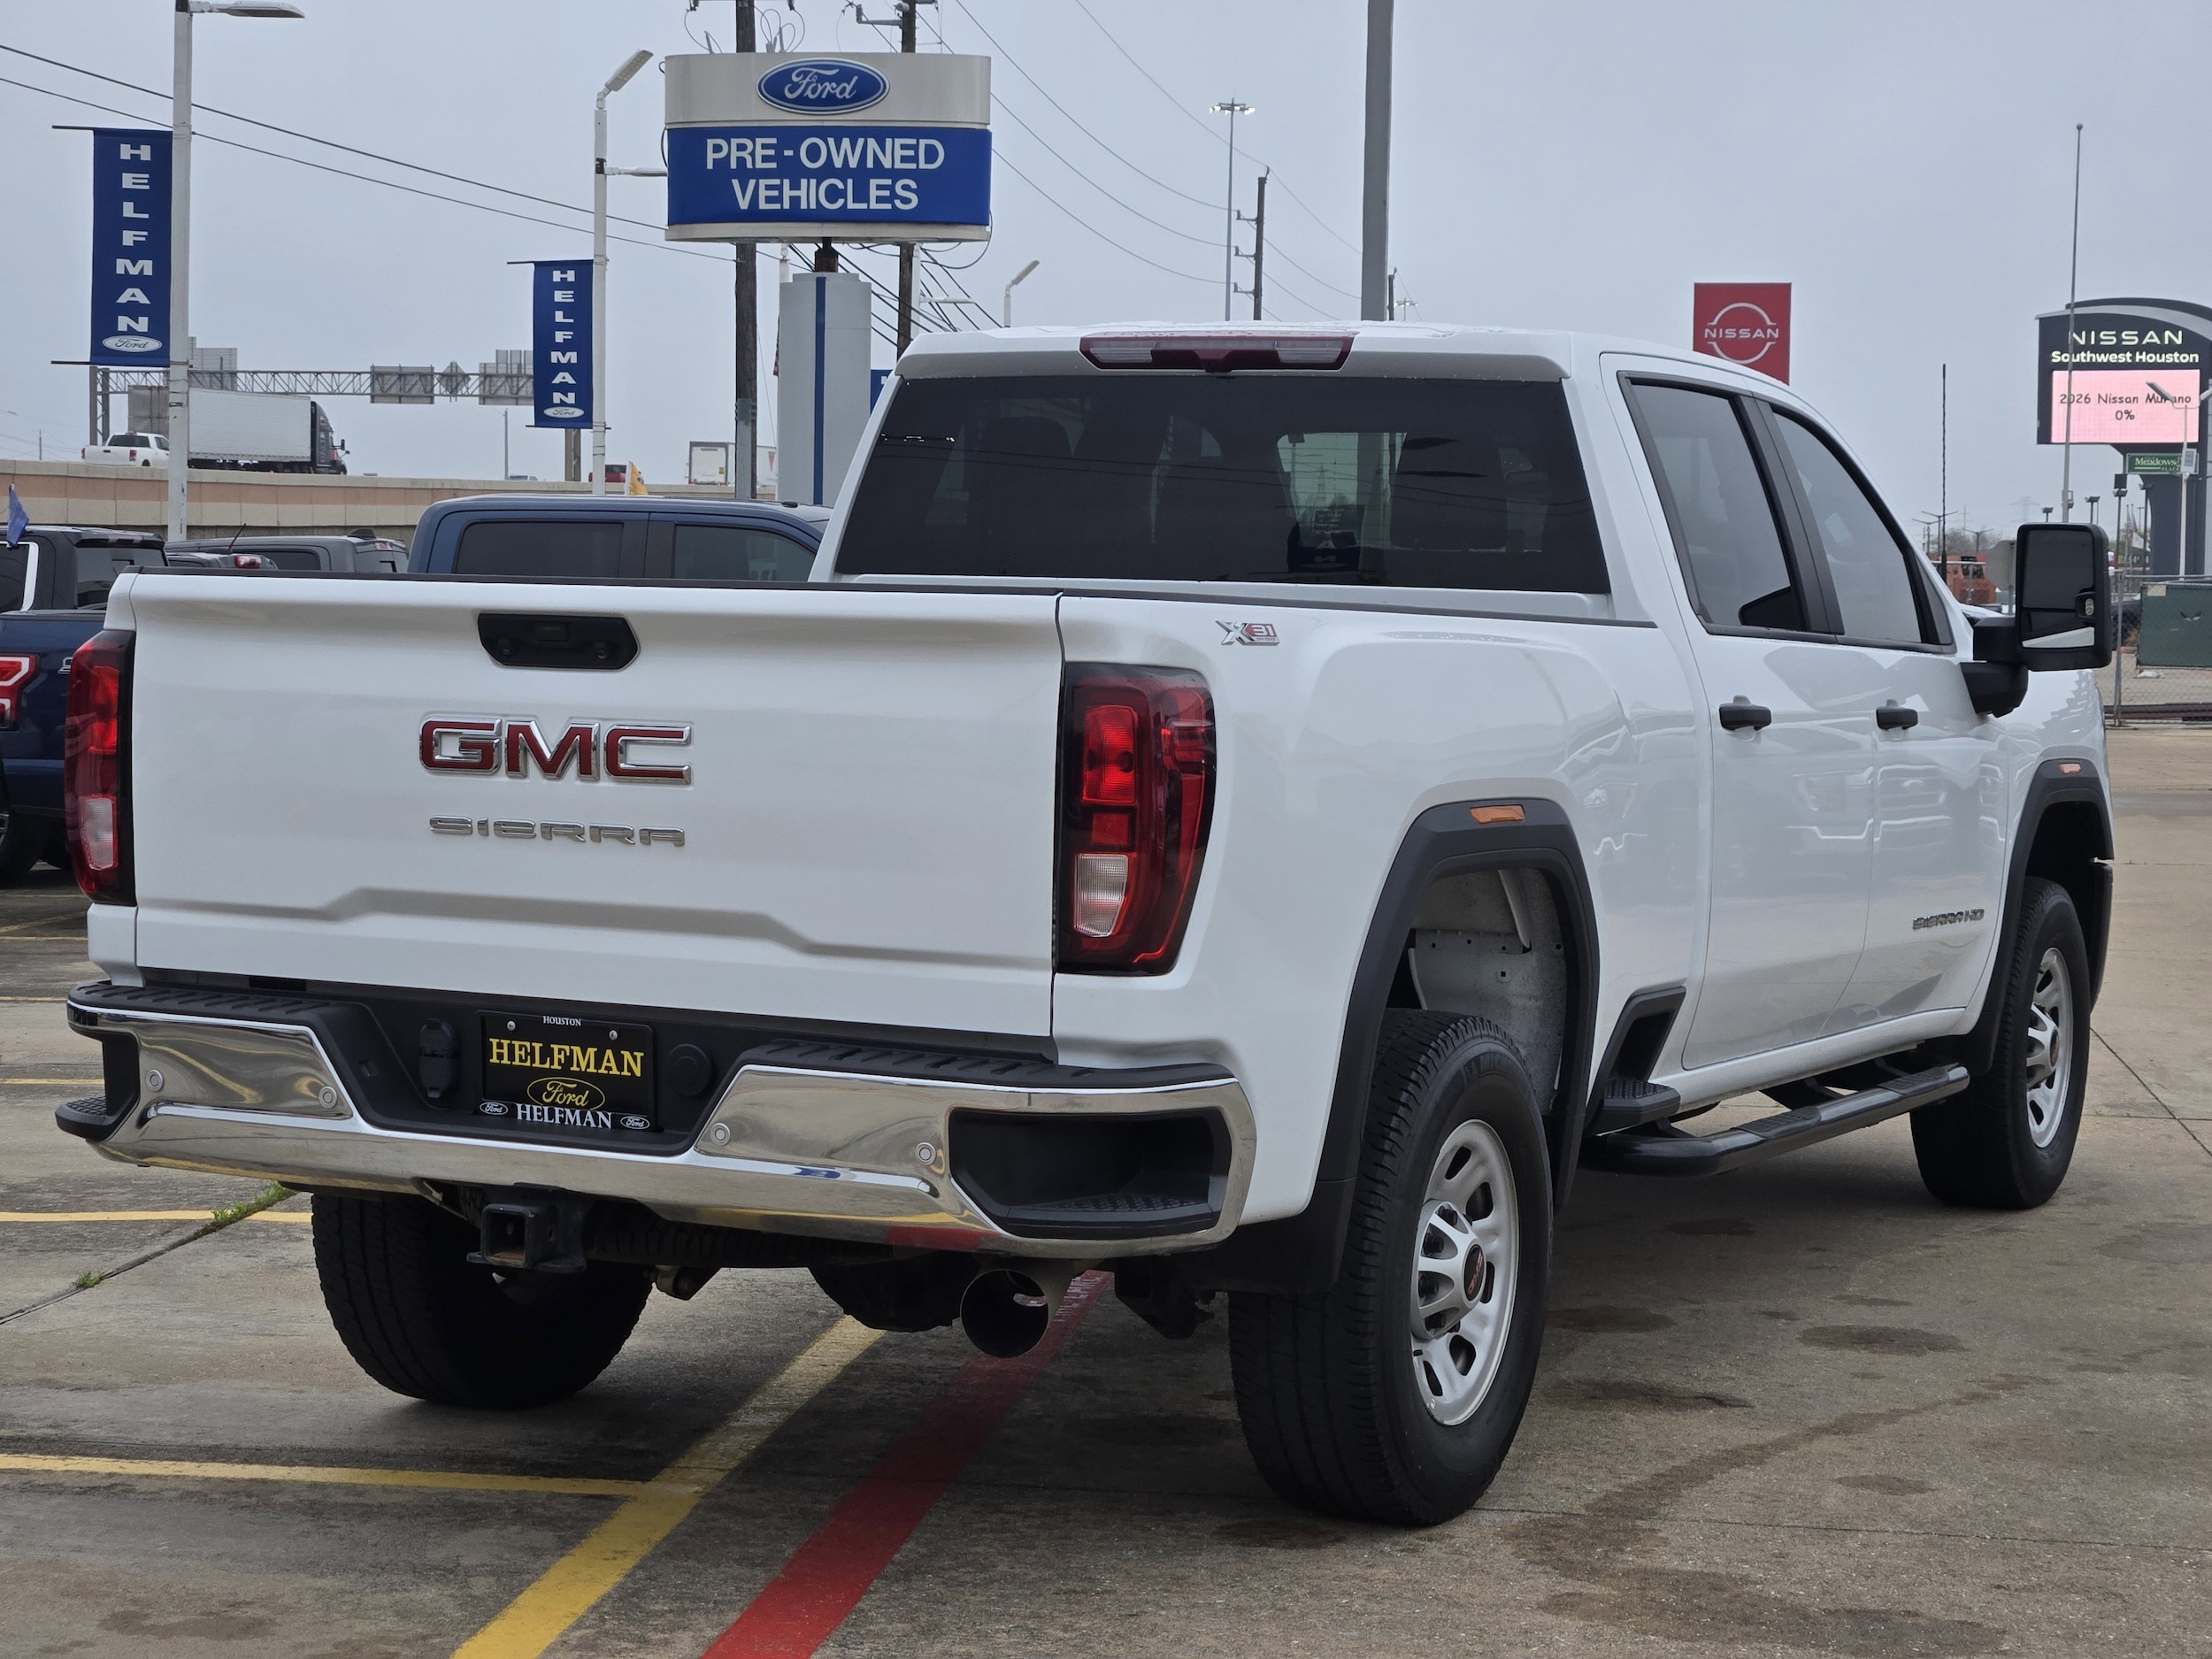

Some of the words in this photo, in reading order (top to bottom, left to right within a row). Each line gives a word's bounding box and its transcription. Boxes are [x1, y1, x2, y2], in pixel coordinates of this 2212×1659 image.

[784, 67, 858, 99] Ford
[731, 178, 919, 211] VEHICLES
[116, 143, 153, 333] HELFMAN
[550, 270, 578, 404] HELFMAN
[1704, 328, 1779, 338] NISSAN
[2069, 330, 2183, 345] NISSAN
[2051, 350, 2132, 363] Southwest
[2135, 351, 2200, 363] Houston
[2060, 393, 2091, 404] 2026
[2098, 393, 2139, 404] Nissan
[2115, 410, 2135, 420] 0%
[2134, 457, 2177, 466] Meadows
[1215, 620, 1278, 646] X31
[419, 715, 692, 786] GMC
[429, 814, 686, 848] SIERRA
[542, 1016, 582, 1026] HOUSTON
[488, 1037, 644, 1078] HELFMAN
[541, 1080, 590, 1107] Ford
[516, 1102, 613, 1130] HELFMAN
